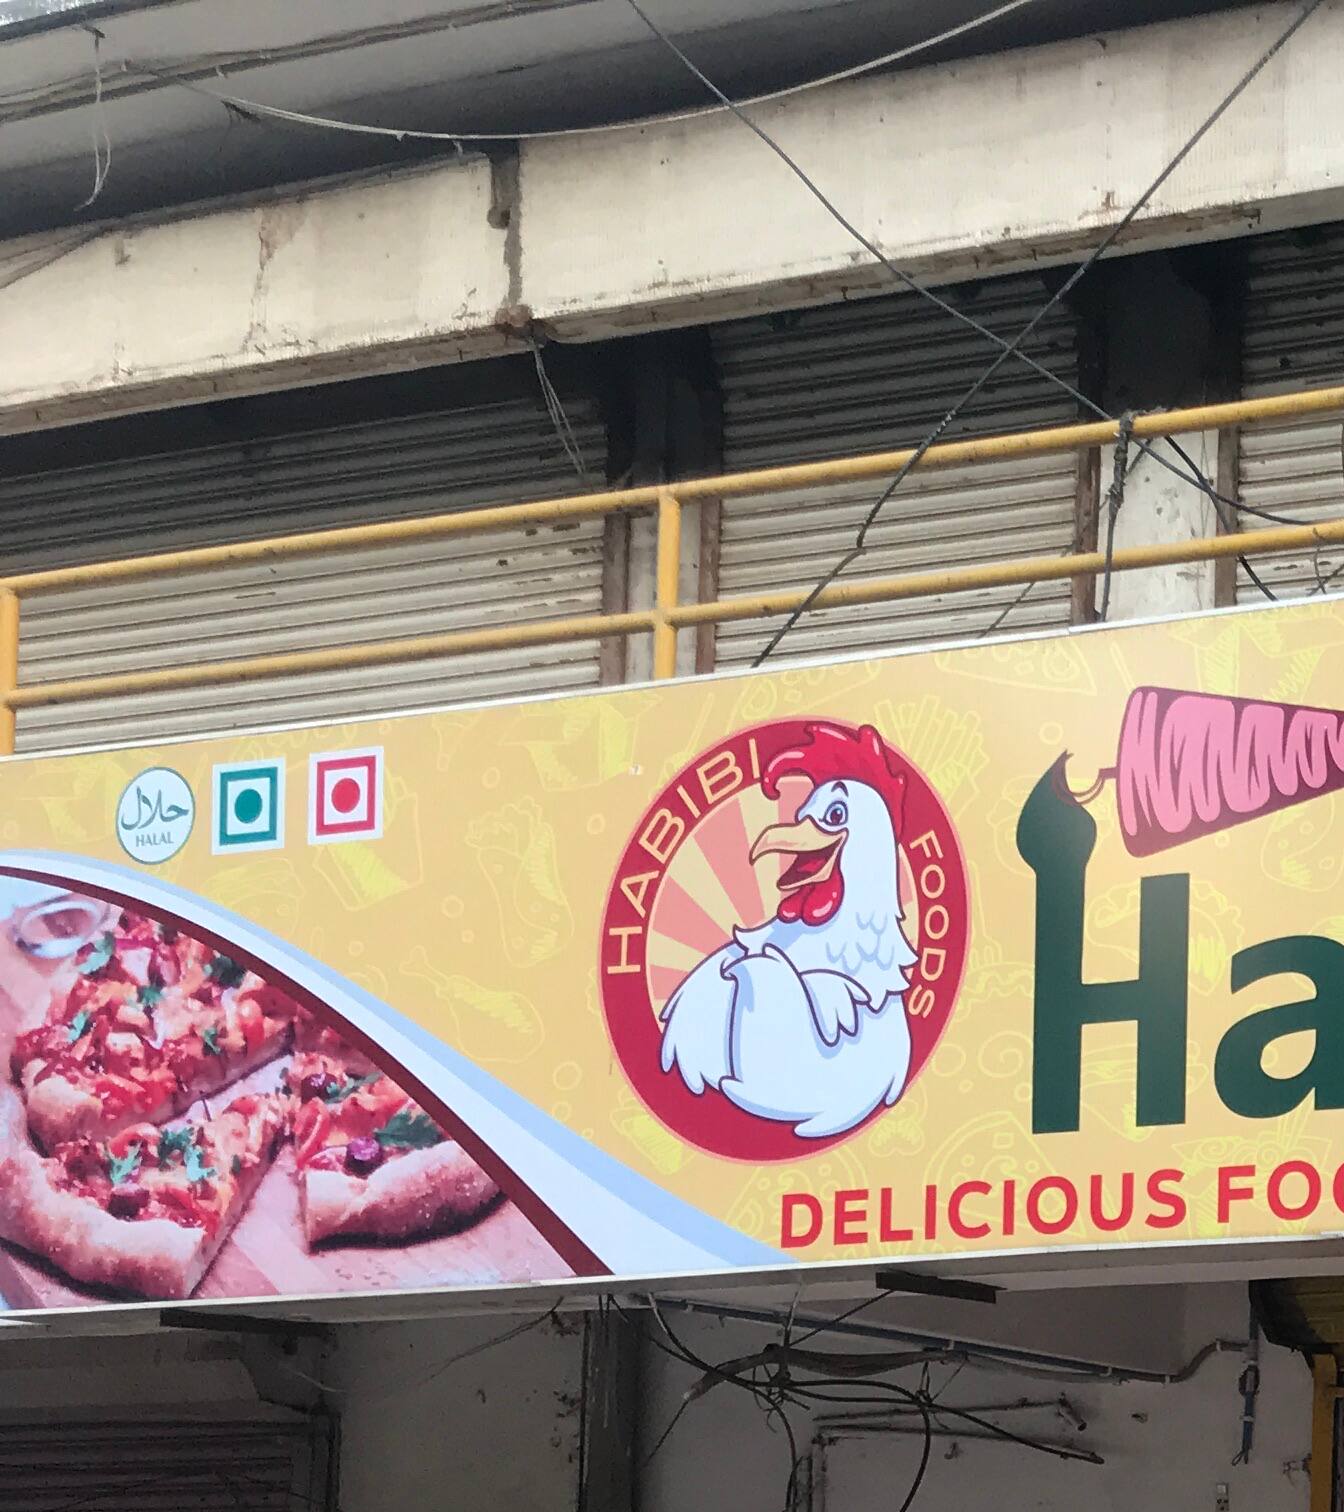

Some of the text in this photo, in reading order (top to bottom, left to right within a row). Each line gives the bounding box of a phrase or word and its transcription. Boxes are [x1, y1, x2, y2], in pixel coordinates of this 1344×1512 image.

[120, 785, 189, 831] حلال
[135, 832, 175, 848] HALAL
[607, 738, 761, 975] HABIBI
[907, 829, 950, 1019] FOODS
[780, 1168, 1186, 1249] DELICIOUS
